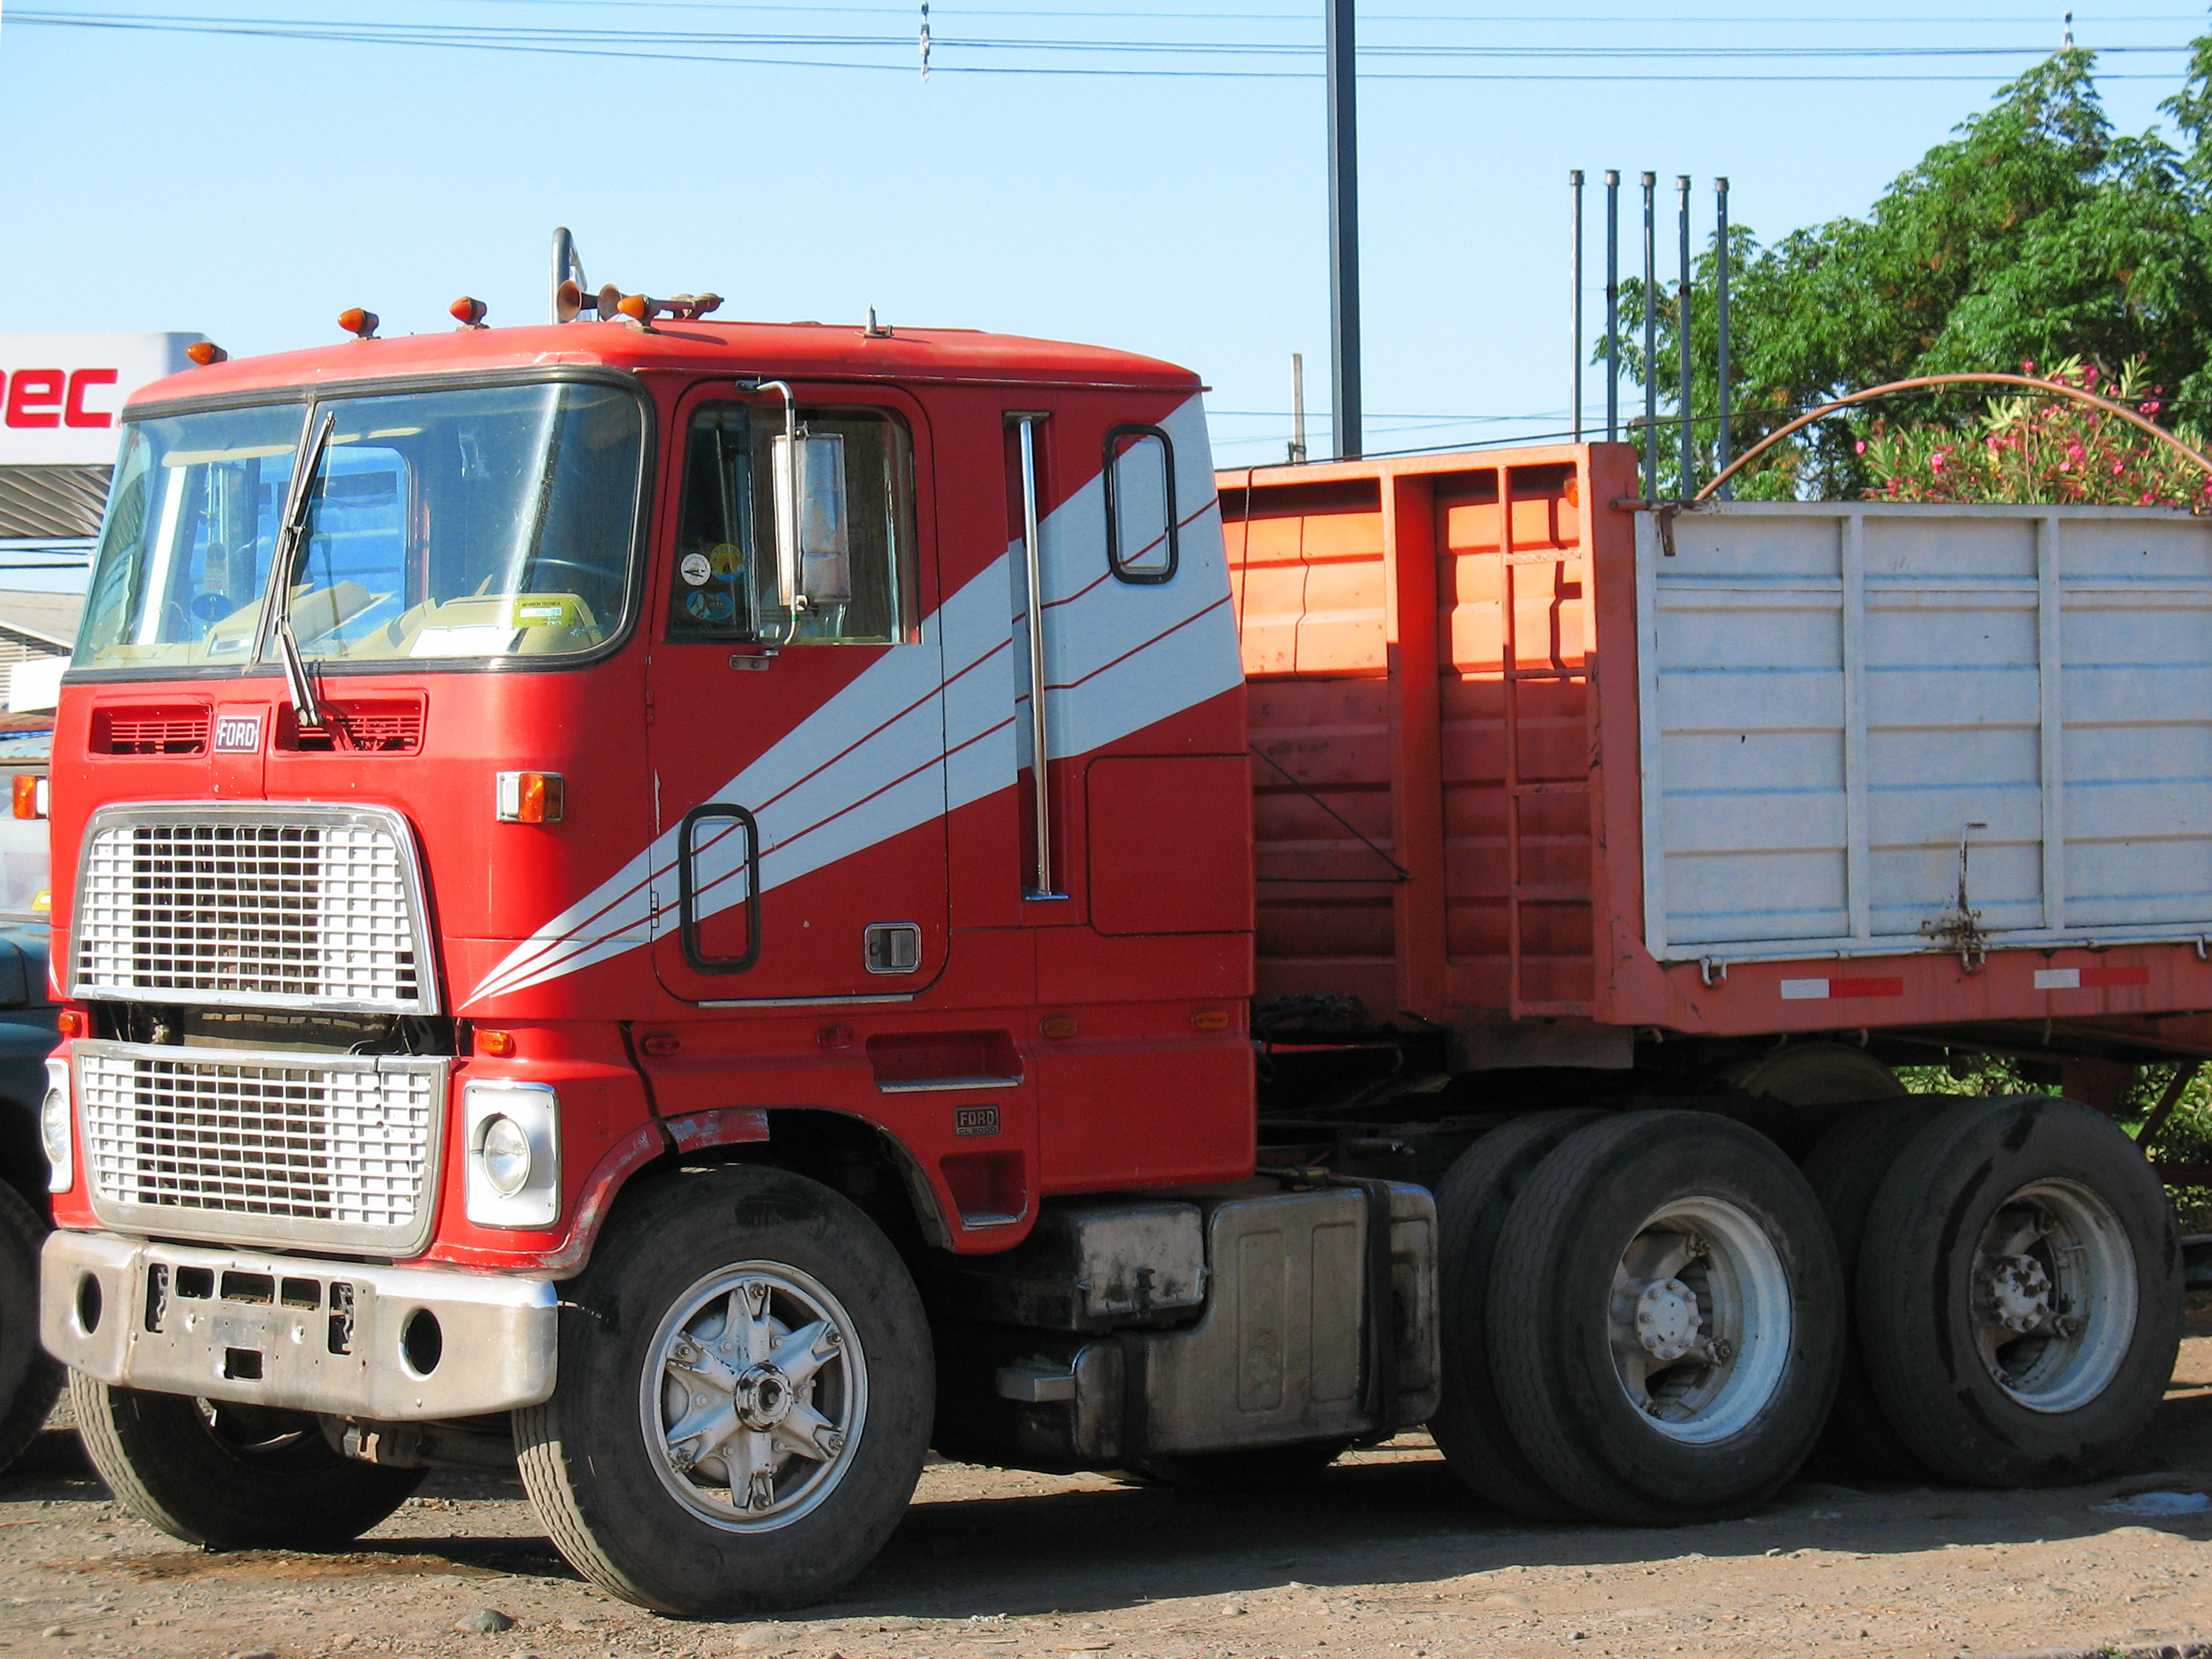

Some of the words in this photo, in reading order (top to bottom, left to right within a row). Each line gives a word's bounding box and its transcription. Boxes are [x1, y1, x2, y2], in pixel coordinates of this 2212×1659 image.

[0, 369, 118, 428] ec
[218, 722, 256, 747] FORD
[960, 1110, 995, 1126] FORD
